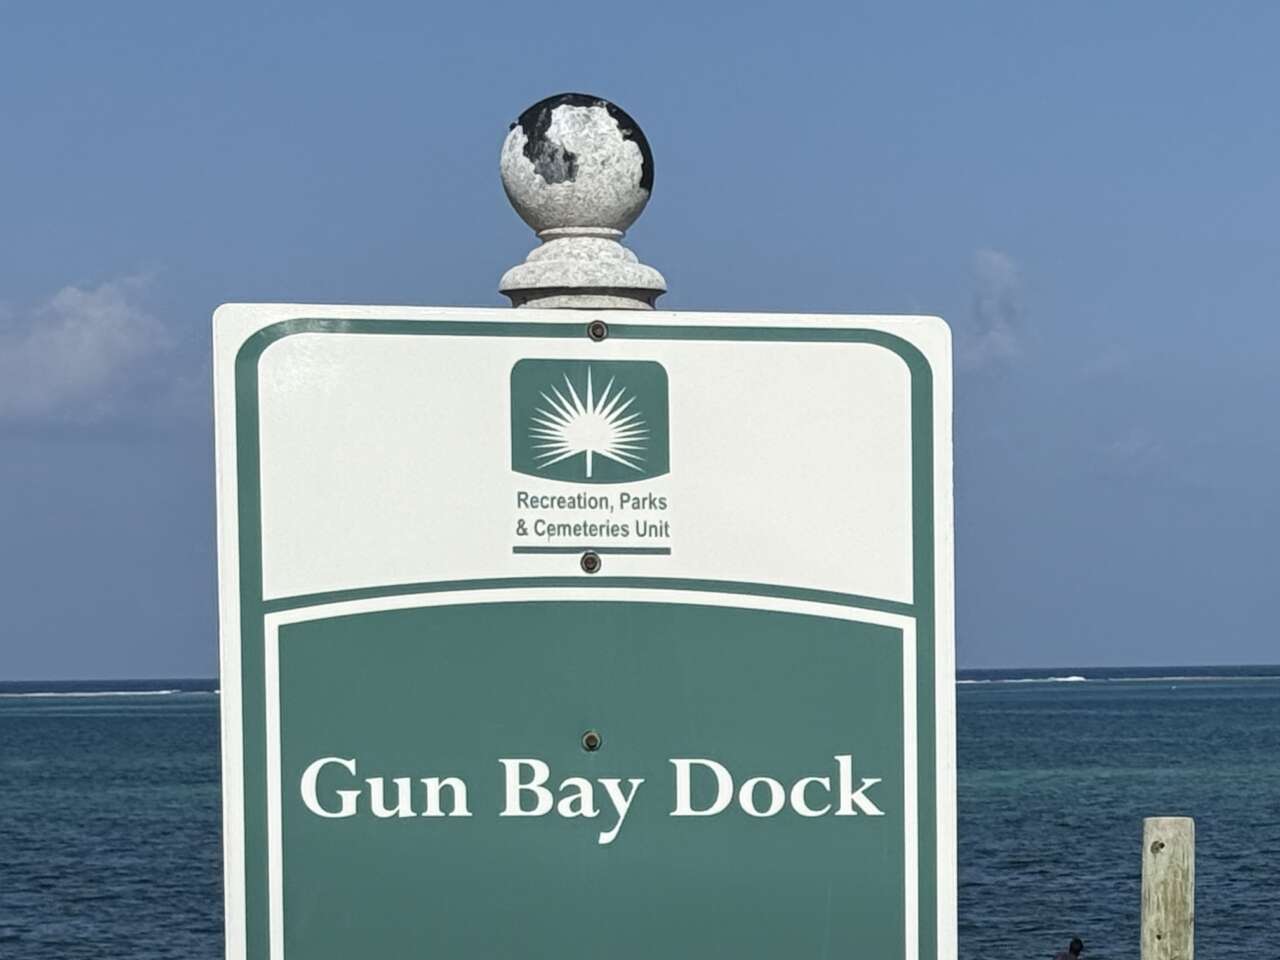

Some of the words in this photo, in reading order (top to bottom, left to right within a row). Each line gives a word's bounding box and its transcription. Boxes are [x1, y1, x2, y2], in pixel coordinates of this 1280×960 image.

[516, 491, 614, 514] Recreation,
[619, 492, 668, 511] Parks
[516, 519, 529, 536] &
[534, 519, 630, 538] Cemeteries
[635, 520, 670, 538] Unit
[300, 757, 473, 819] Gun
[498, 757, 645, 845] Bay
[669, 754, 885, 818] Dock
